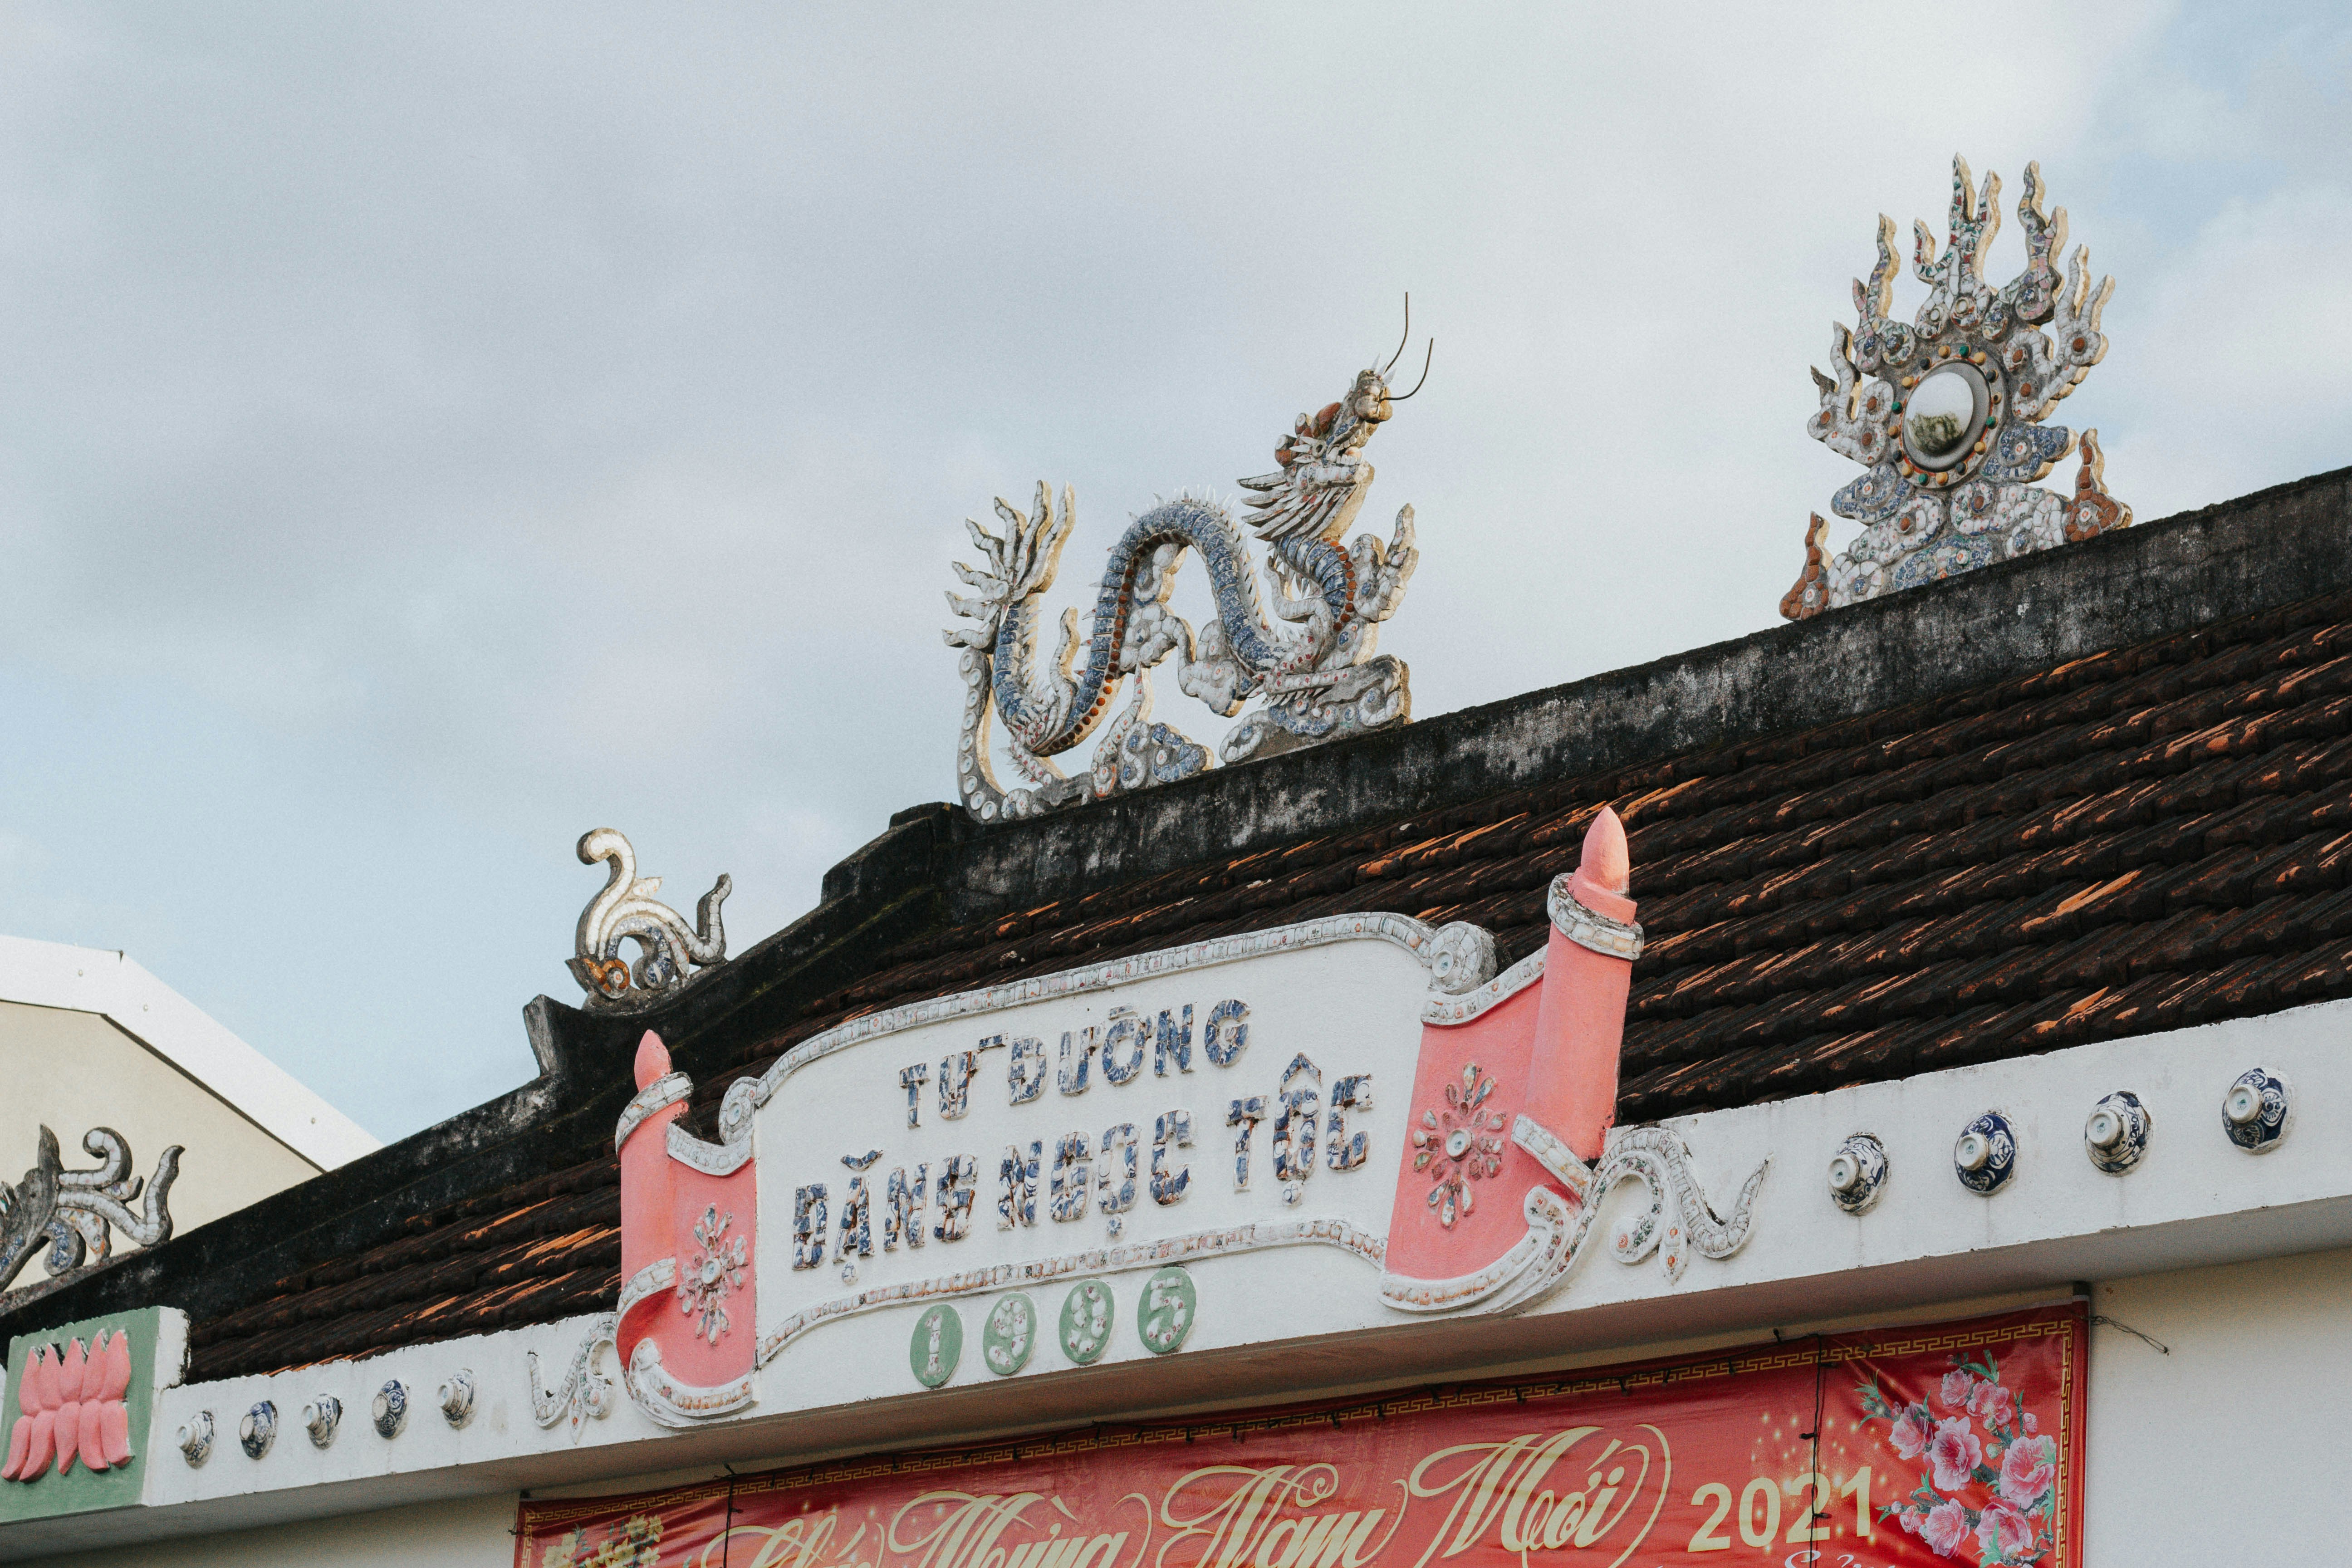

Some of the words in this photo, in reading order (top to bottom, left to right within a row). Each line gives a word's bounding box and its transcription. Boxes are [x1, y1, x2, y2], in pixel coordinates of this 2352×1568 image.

[1008, 999, 1250, 1105] ĐƯỜNG
[792, 1150, 978, 1284] ĐẶNG
[998, 1110, 1196, 1238] NGỌC
[1225, 1053, 1373, 1206] TỘC
[1409, 1424, 1671, 1568] Mới
[1688, 1466, 1872, 1552] 2021
